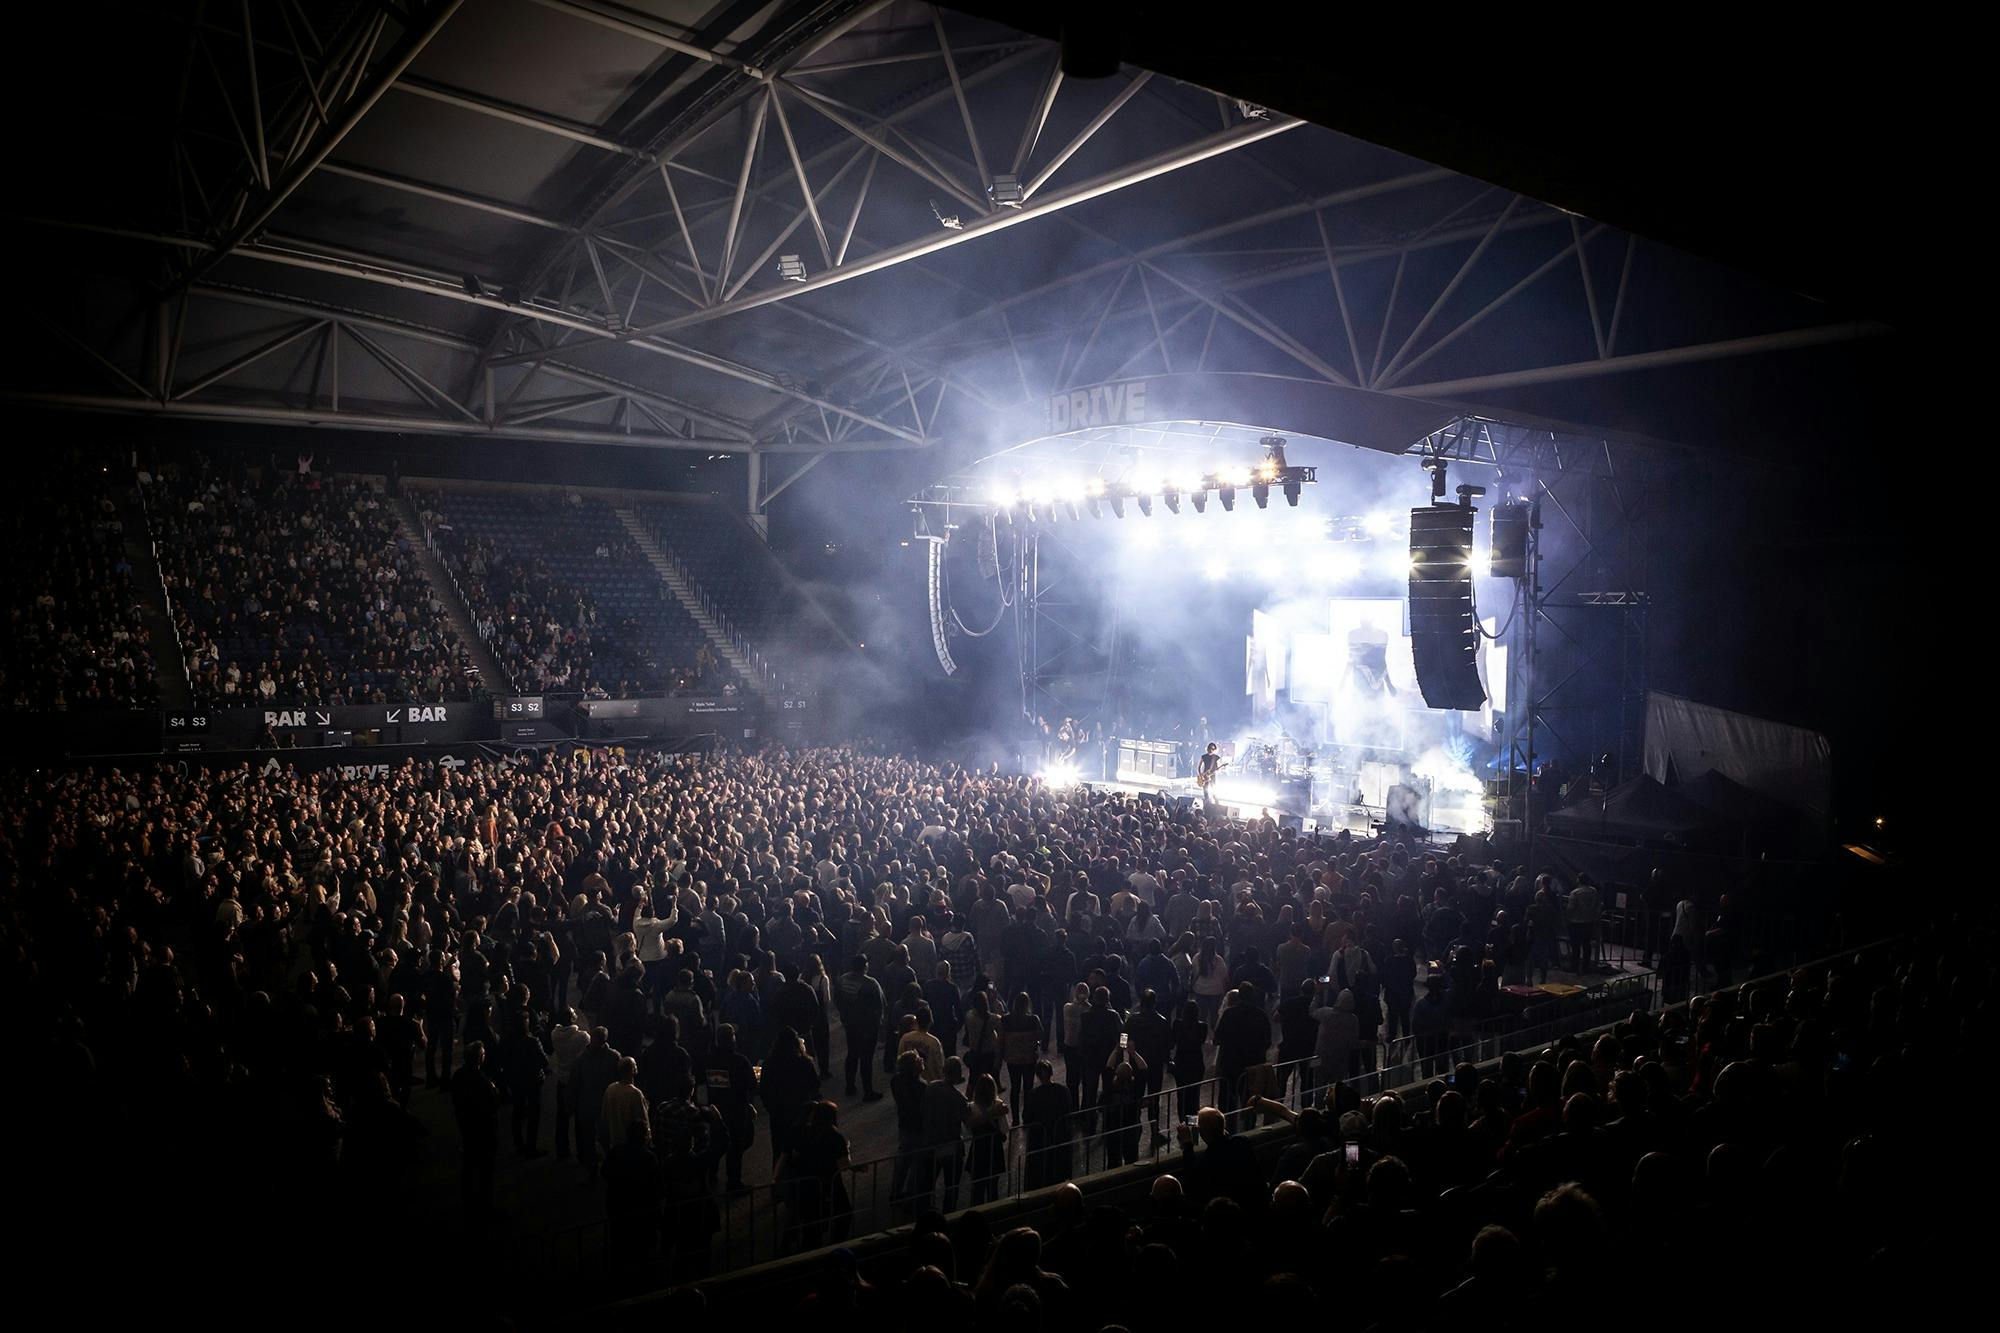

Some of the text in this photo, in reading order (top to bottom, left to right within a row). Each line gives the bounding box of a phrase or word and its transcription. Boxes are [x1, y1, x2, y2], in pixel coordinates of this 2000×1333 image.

[1051, 382, 1146, 432] DRIVE
[408, 706, 447, 723] BAR
[511, 702, 540, 712] S3 S2
[170, 716, 207, 727] S4 S3
[264, 711, 307, 727] BAR
